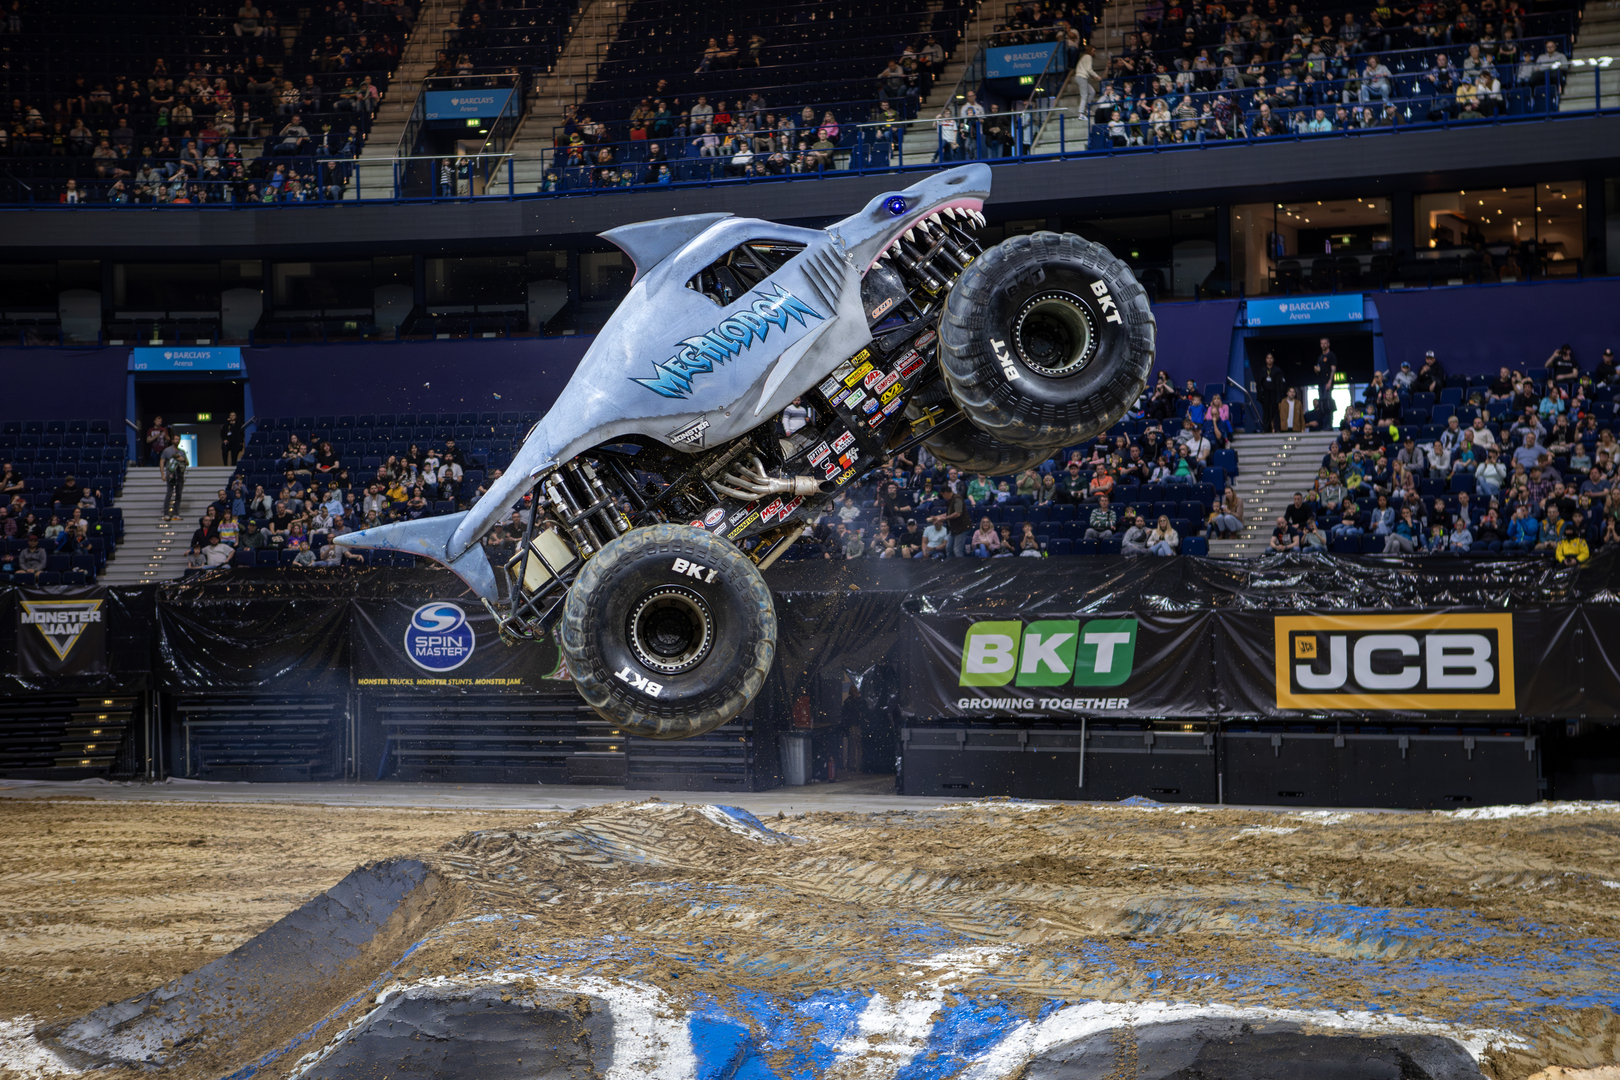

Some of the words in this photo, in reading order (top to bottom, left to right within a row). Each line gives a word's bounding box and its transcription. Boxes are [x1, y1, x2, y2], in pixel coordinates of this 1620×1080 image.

[1012, 51, 1048, 61] BARCLAYS
[1090, 280, 1122, 325] BKT
[1289, 301, 1330, 312] BARCLAYS
[628, 281, 826, 399] MEGALODON
[990, 338, 1020, 382] BKT
[864, 370, 881, 386] JAZ
[877, 372, 897, 391] SIMPSON
[670, 420, 710, 444] MONSTER
[686, 430, 704, 443] JAM
[810, 442, 827, 461] OPTIMA
[836, 467, 856, 485] UNOH
[730, 508, 749, 524] Holley
[761, 498, 781, 519] MSD
[779, 495, 803, 519] ARP
[21, 611, 101, 624] MONSTER
[44, 623, 80, 634] JAM
[415, 636, 462, 647] SPIN
[966, 632, 1130, 673] BKT
[1295, 634, 1494, 690] JCB
[614, 667, 663, 697] BKT
[958, 698, 1034, 709] GROWING
[1039, 698, 1129, 709] TOGETHER
